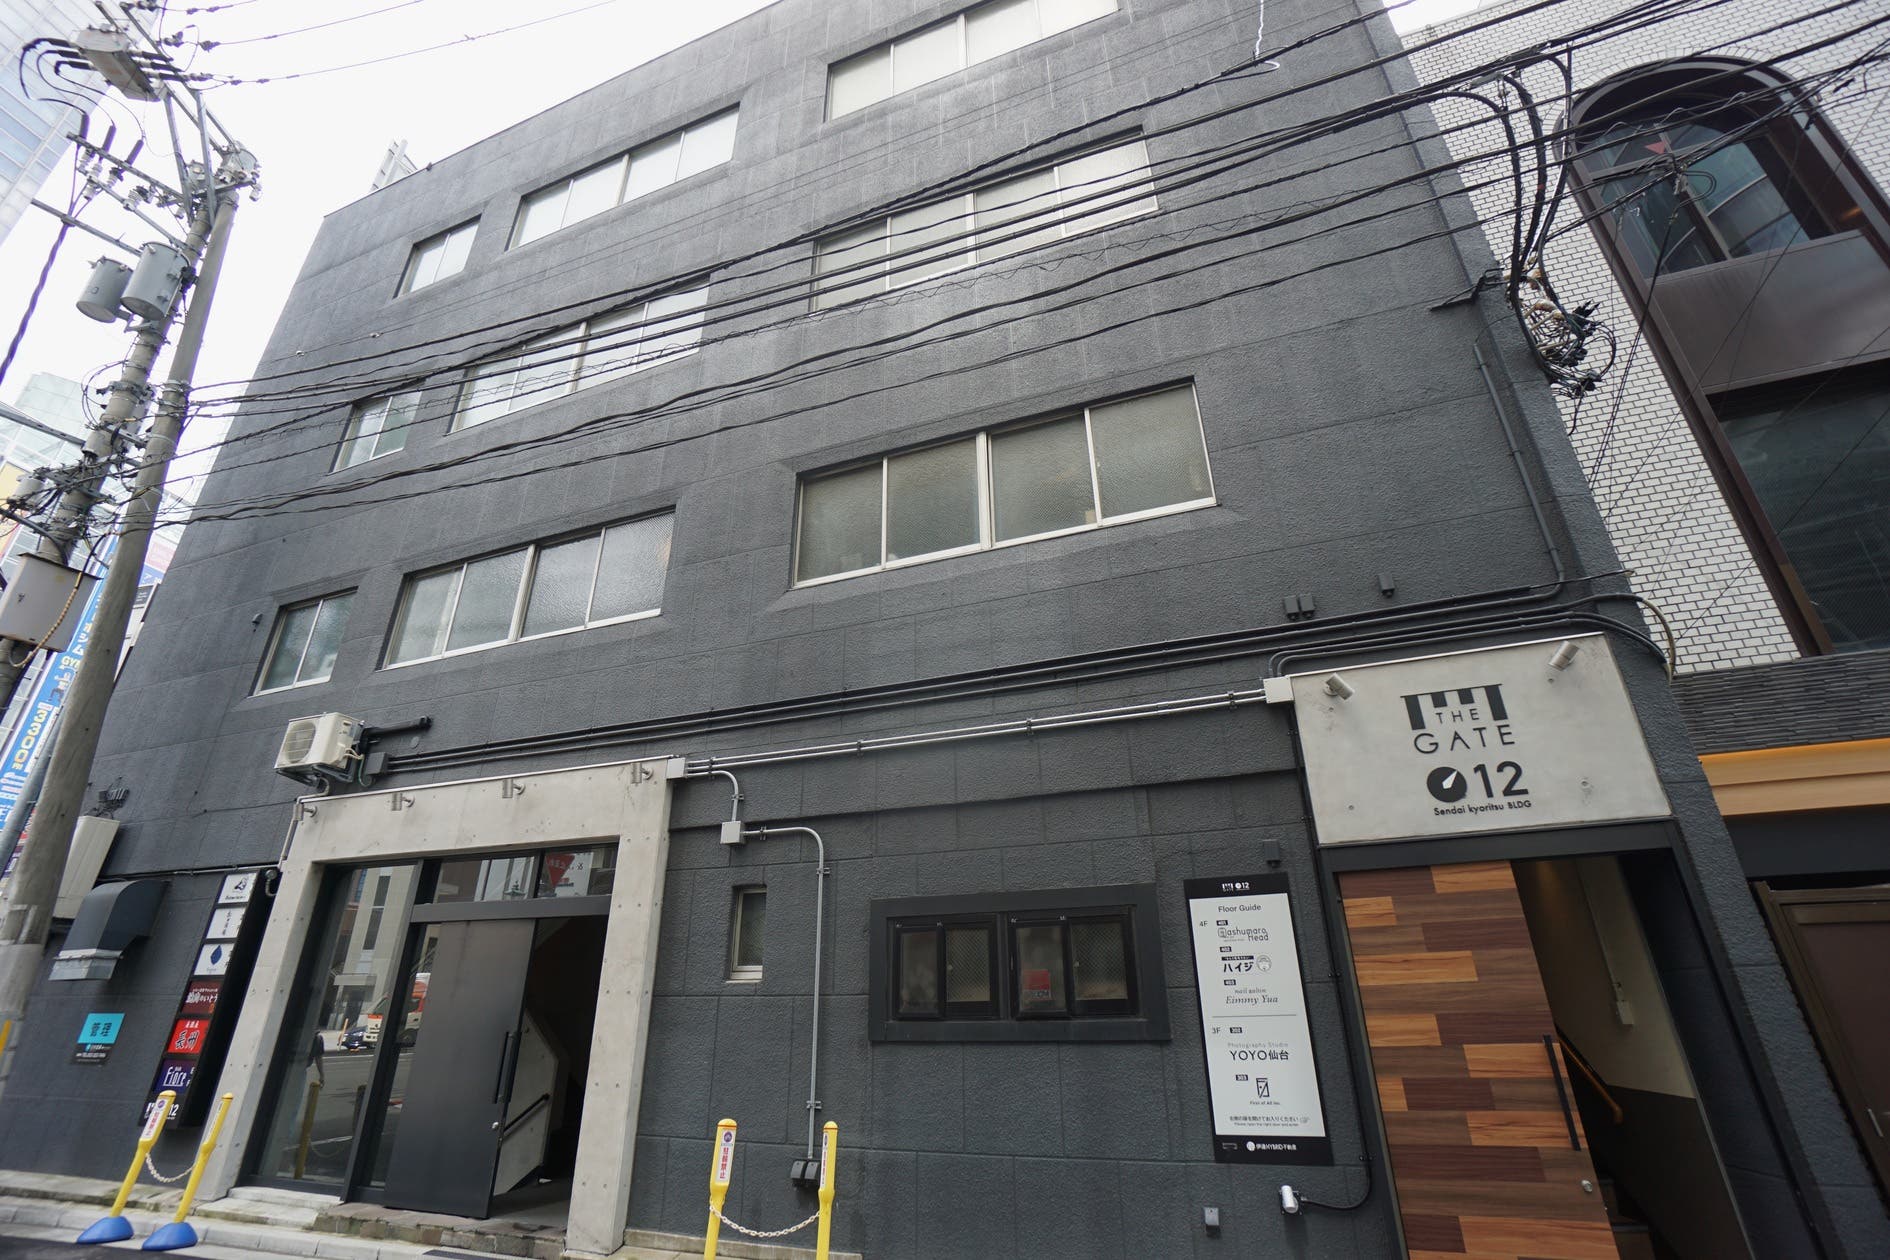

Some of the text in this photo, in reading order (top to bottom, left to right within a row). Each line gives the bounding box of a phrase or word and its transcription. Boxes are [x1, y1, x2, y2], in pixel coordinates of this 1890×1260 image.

[1435, 708, 1480, 724] THE
[1414, 724, 1515, 754] GATE
[1433, 800, 1532, 816] Sendai kyoritsu BLDG
[1218, 903, 1261, 913] Floor Guide
[1223, 961, 1254, 973] ハイジ
[1229, 1049, 1289, 1061] YOYO仙台
